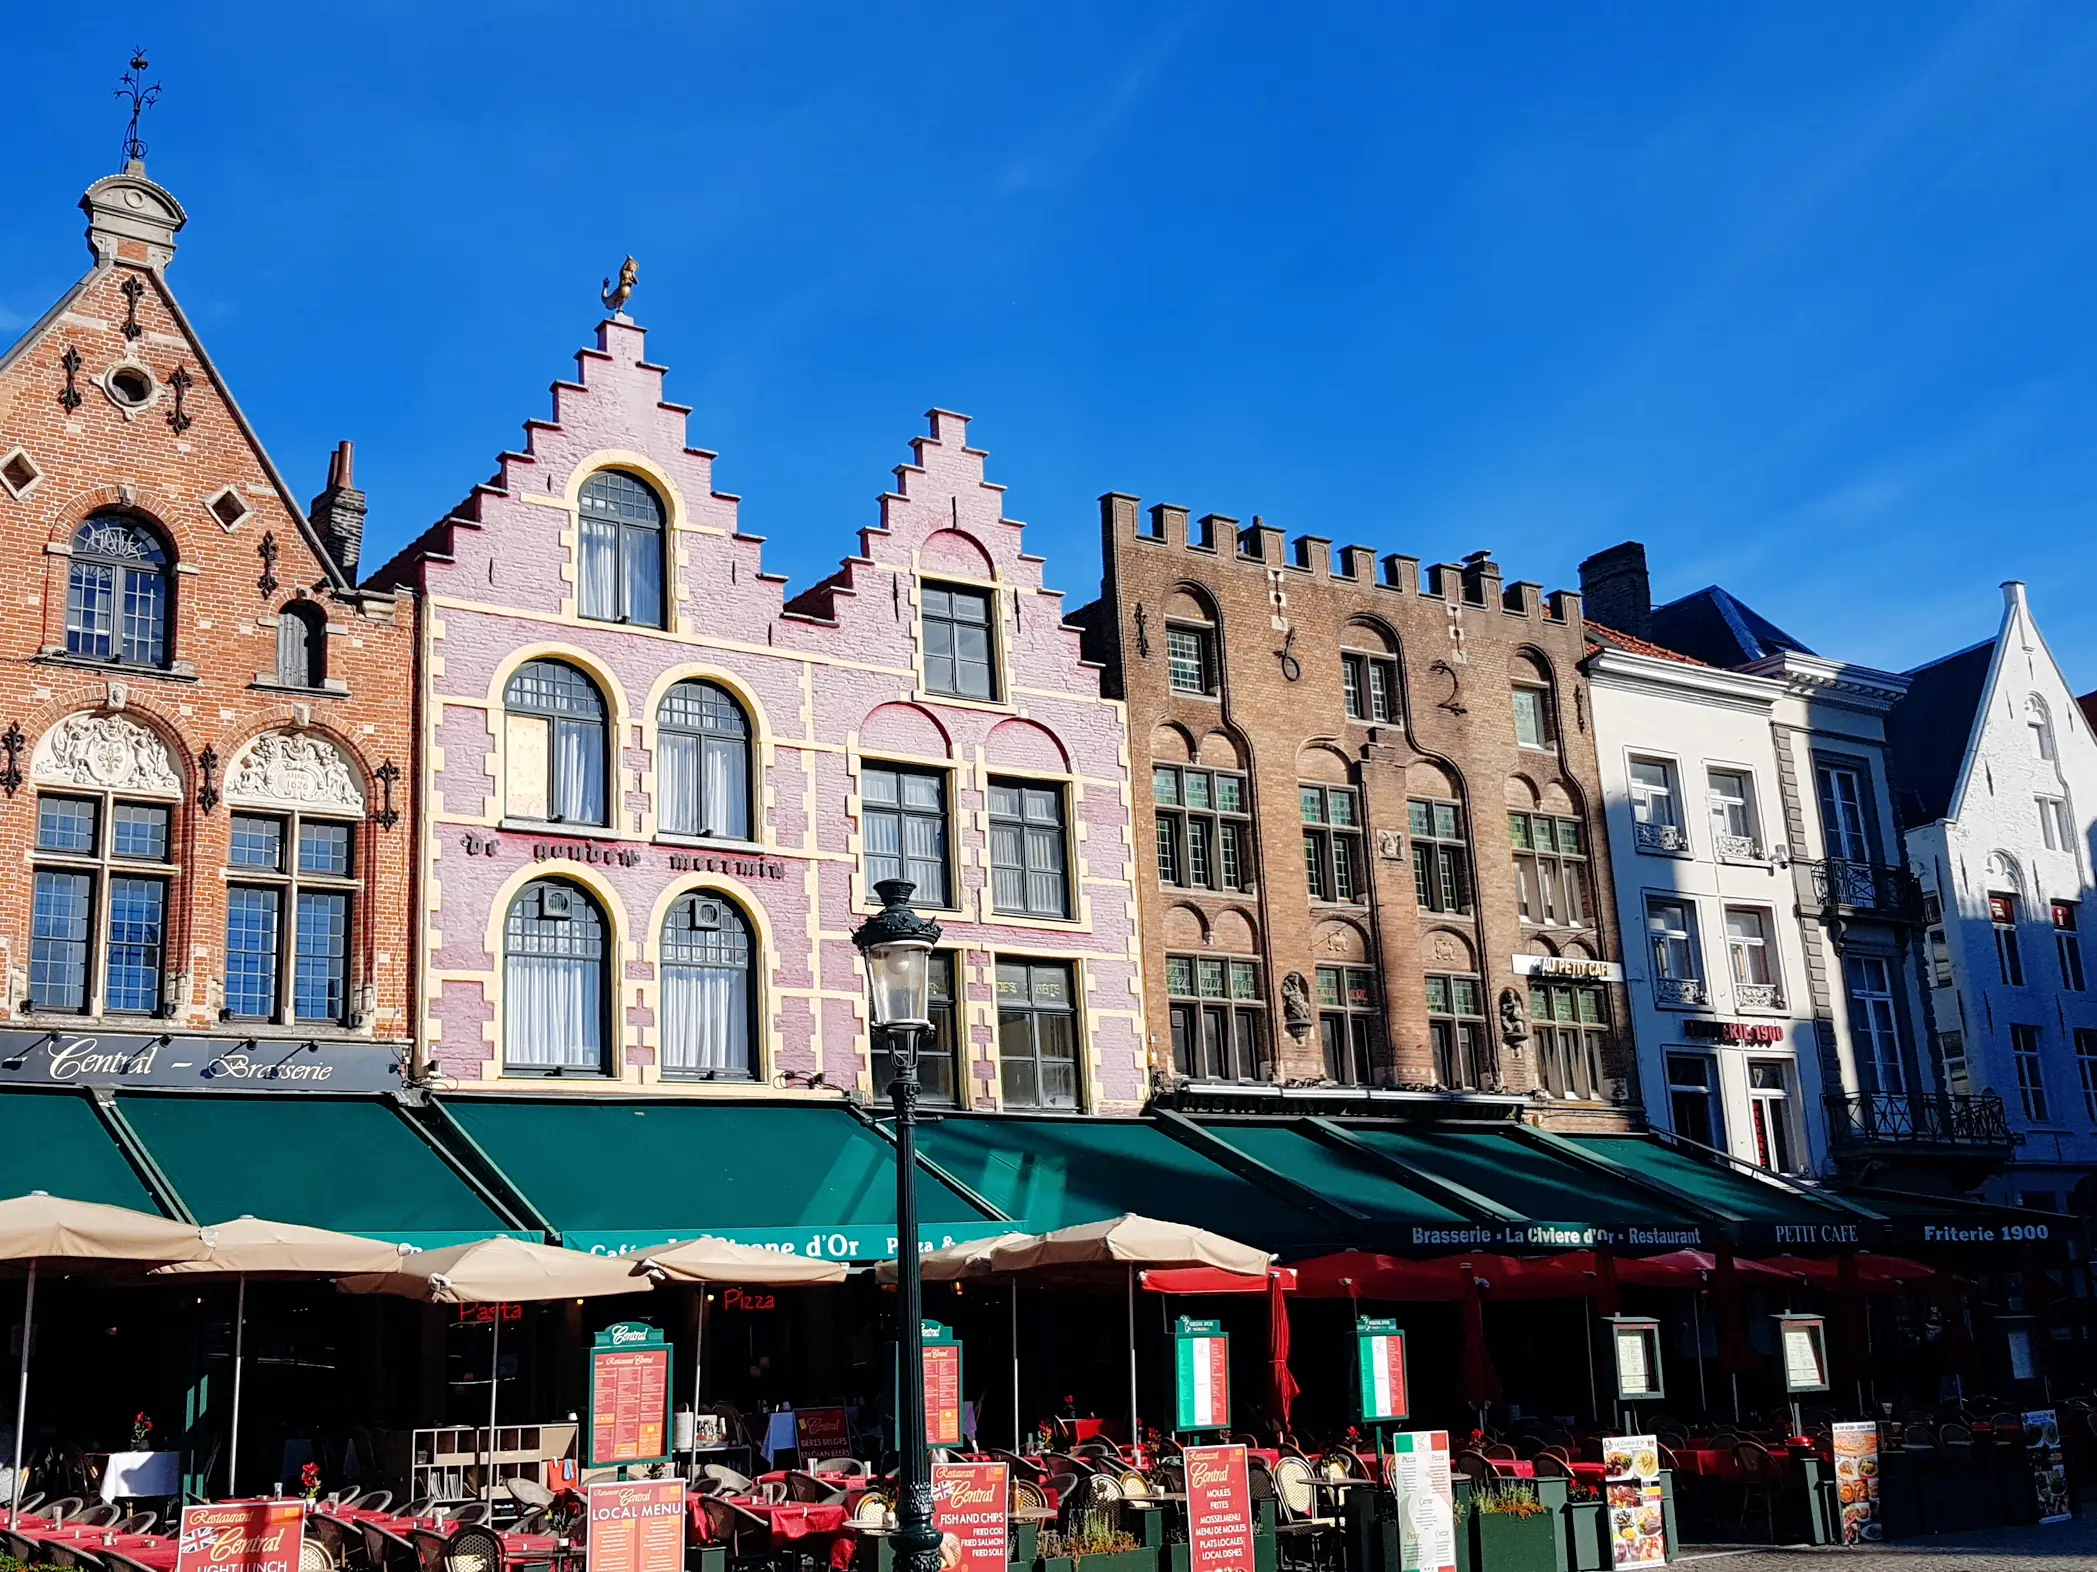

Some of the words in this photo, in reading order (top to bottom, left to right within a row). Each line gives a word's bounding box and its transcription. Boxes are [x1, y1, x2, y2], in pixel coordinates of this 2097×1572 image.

[1542, 957, 1556, 973] AU
[1558, 960, 1586, 976] PETIT
[1754, 1025, 1784, 1042] 1900
[48, 1035, 157, 1080] Central
[208, 1053, 335, 1081] Brasserie
[1412, 1226, 1491, 1244] Brasserie
[1505, 1227, 1524, 1243] La
[1527, 1227, 1580, 1244] Civiere
[1629, 1227, 1701, 1244] Restaurant
[1775, 1225, 1817, 1243] PETIT
[1821, 1225, 1859, 1242] CAFE
[1924, 1225, 1995, 1241] Friterie
[2001, 1224, 2049, 1240] 1900
[805, 1234, 860, 1257] d'Or
[886, 1237, 935, 1254] Pza
[724, 1287, 775, 1310] Pizza
[612, 1325, 648, 1345] Central
[1190, 1462, 1229, 1488] Central
[619, 1487, 652, 1507] Central
[950, 1480, 995, 1508] Central
[1206, 1487, 1231, 1498] MOULES
[592, 1505, 638, 1521] LOCAL
[641, 1502, 682, 1517] MENU
[1210, 1500, 1229, 1510] FRITES
[189, 1510, 254, 1525] Restaurant
[940, 1513, 959, 1525] FISH
[960, 1513, 979, 1524] AND
[980, 1512, 1004, 1523] CHIPS
[973, 1528, 988, 1537] FRIED
[1195, 1526, 1214, 1537] MENU
[1222, 1524, 1247, 1534] MOULES
[210, 1526, 286, 1562] Central
[961, 1538, 977, 1548] FRIED
[977, 1537, 1004, 1546] SALMON
[1200, 1538, 1217, 1549] PLATS
[972, 1549, 988, 1558] FRIED
[988, 1547, 1004, 1556] SOLE
[1202, 1550, 1222, 1561] LOCAL
